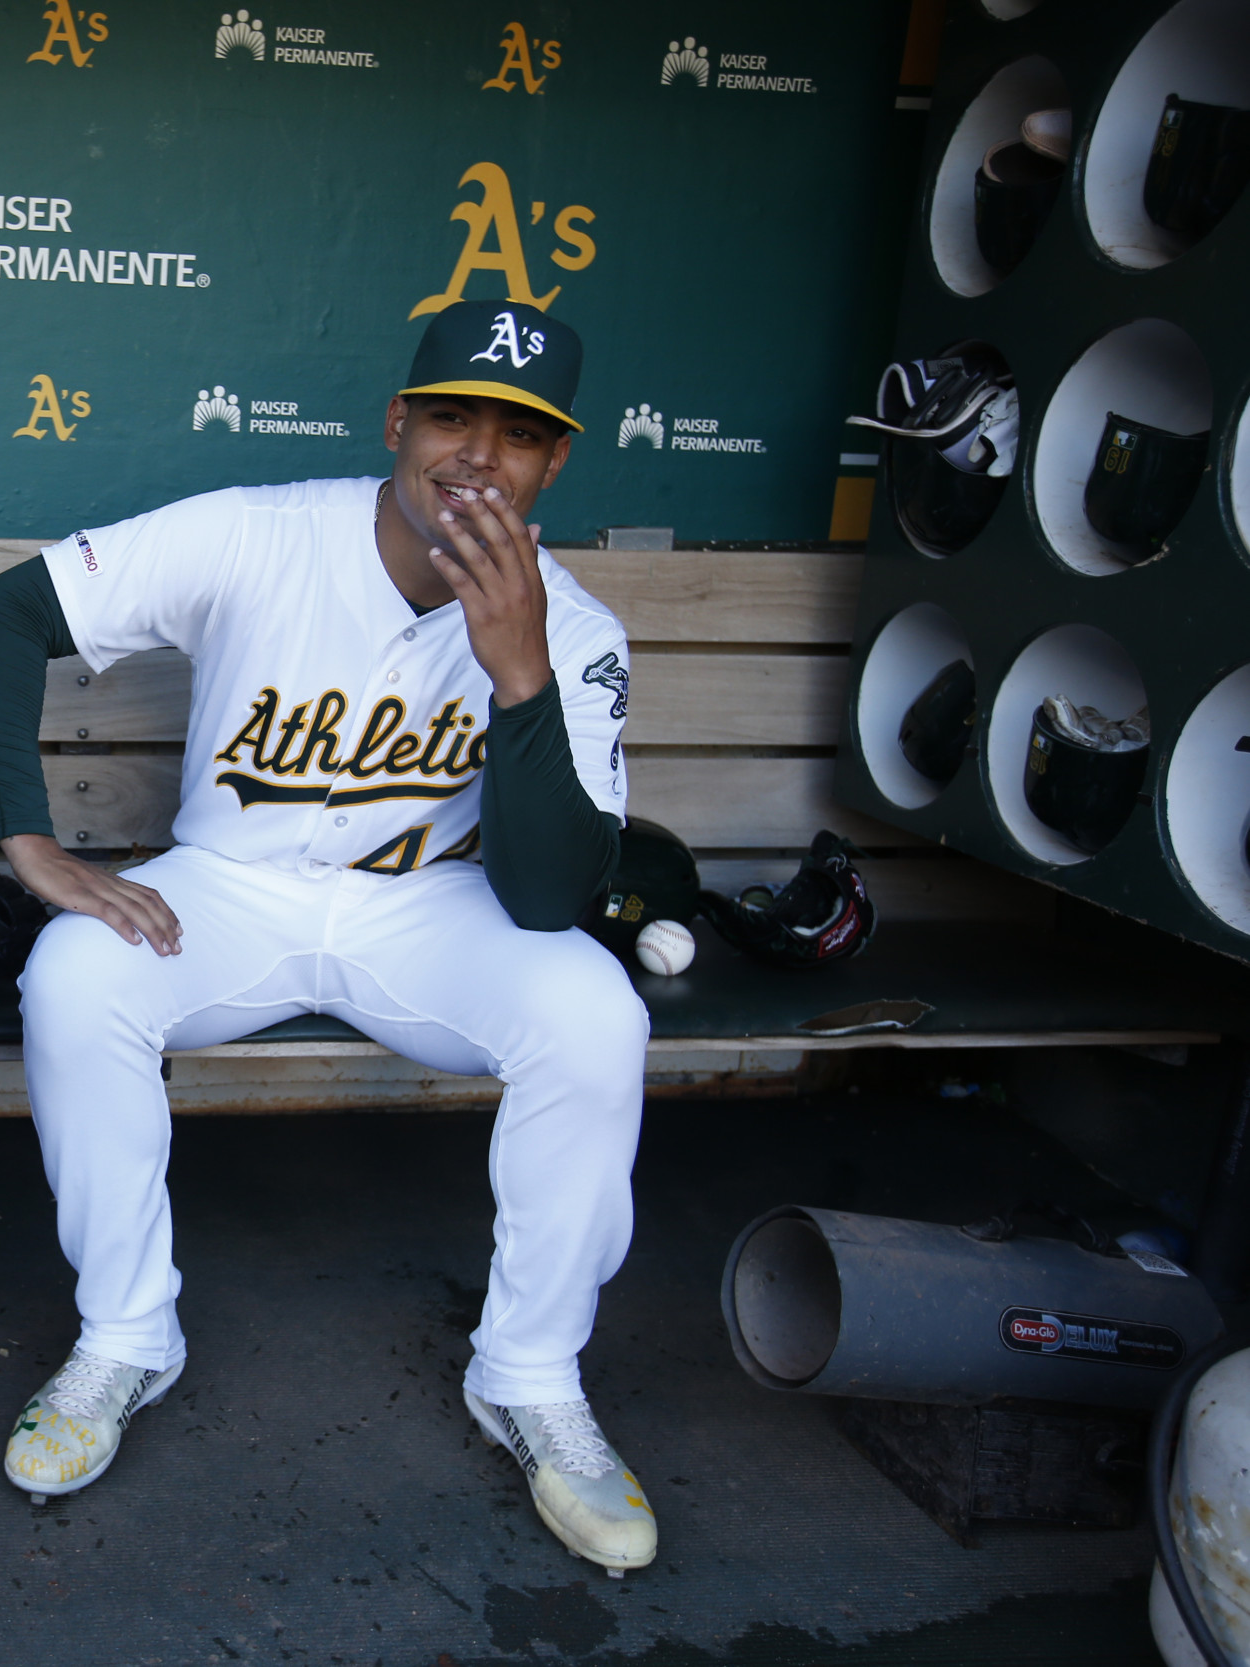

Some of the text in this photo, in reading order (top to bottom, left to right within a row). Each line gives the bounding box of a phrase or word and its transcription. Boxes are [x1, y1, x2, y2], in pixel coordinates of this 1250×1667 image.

[27, 0, 108, 67] A's
[276, 27, 326, 45] KAISER
[275, 48, 374, 67] PERMANENTE
[482, 22, 562, 95] A's
[720, 54, 767, 71] KAISER
[717, 74, 813, 93] PERMANENTE
[408, 162, 596, 321] A's
[469, 311, 544, 369] A's
[13, 374, 91, 442] A's
[251, 401, 298, 416] KAISER
[250, 419, 346, 437] PERMANENTE
[674, 418, 719, 434] KAISER
[672, 436, 763, 453] PERMANENTE
